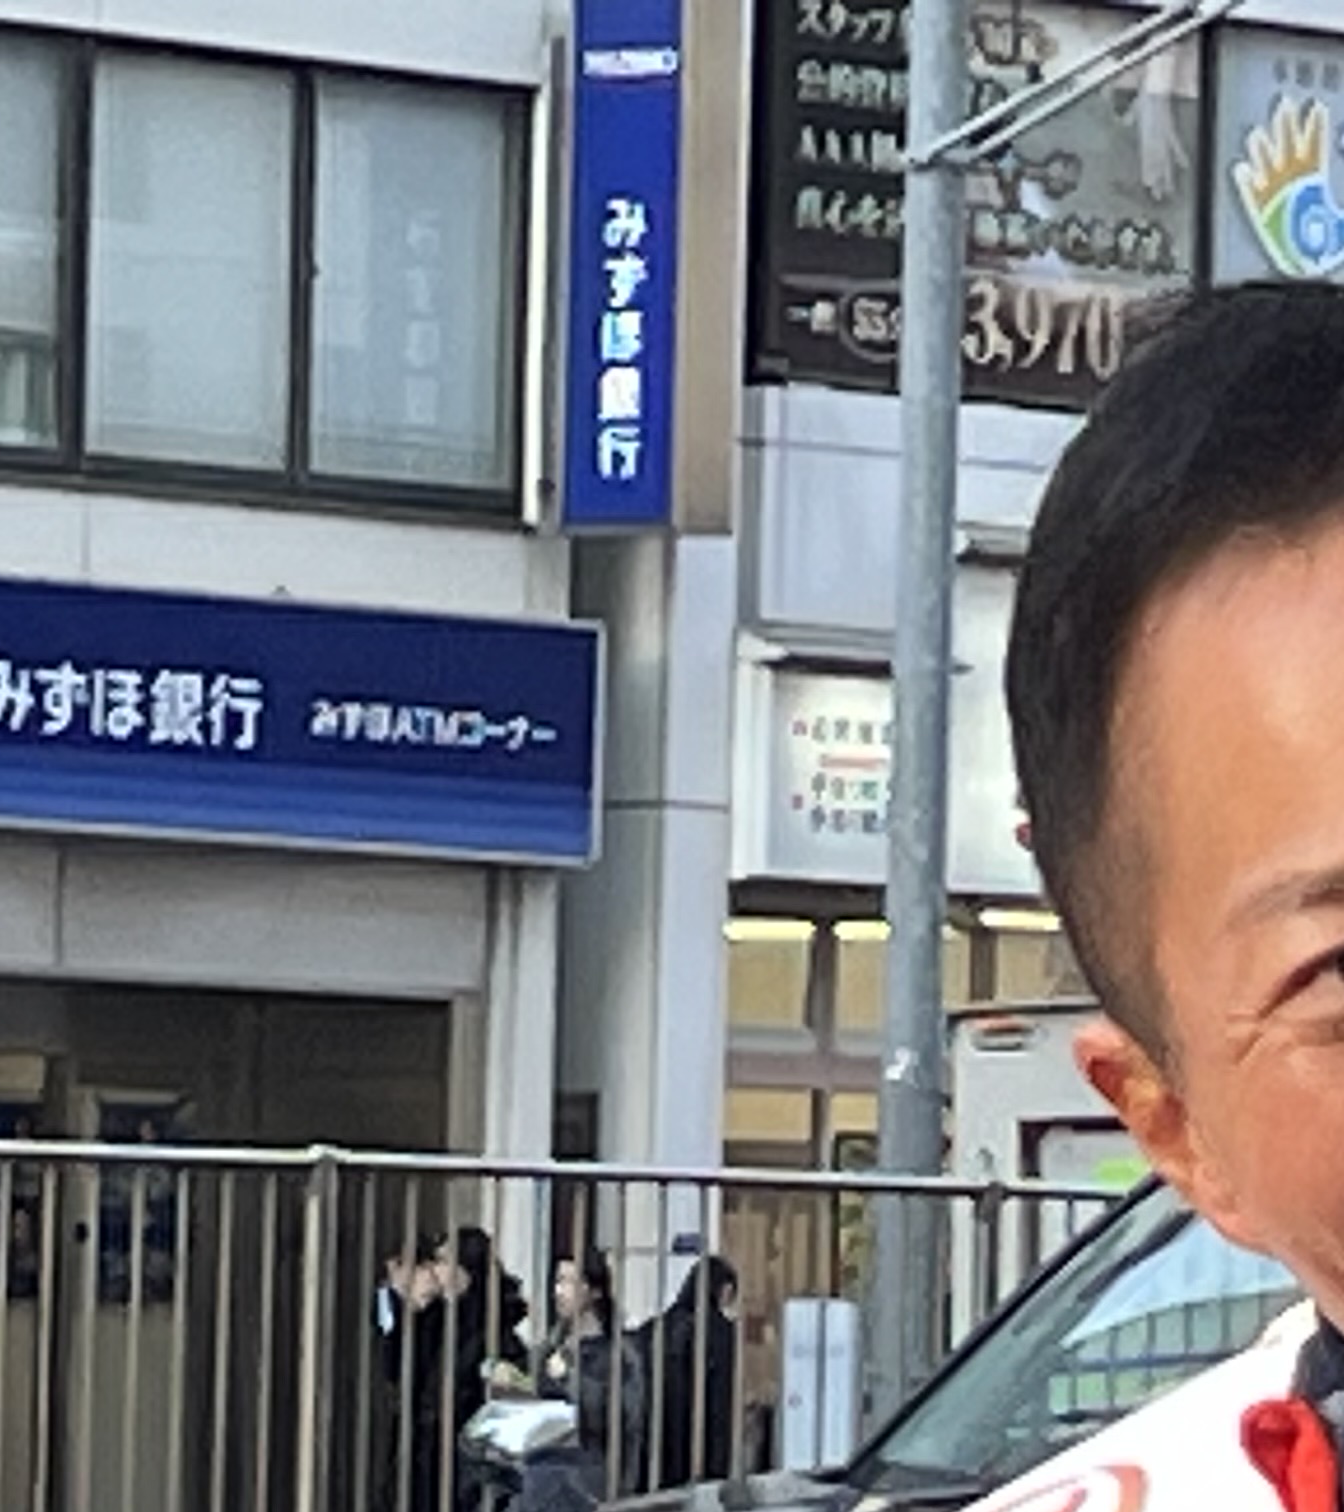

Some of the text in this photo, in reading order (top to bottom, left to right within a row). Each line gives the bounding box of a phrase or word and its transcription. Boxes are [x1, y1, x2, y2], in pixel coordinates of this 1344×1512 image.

[598, 198, 647, 480] みずほ銀行
